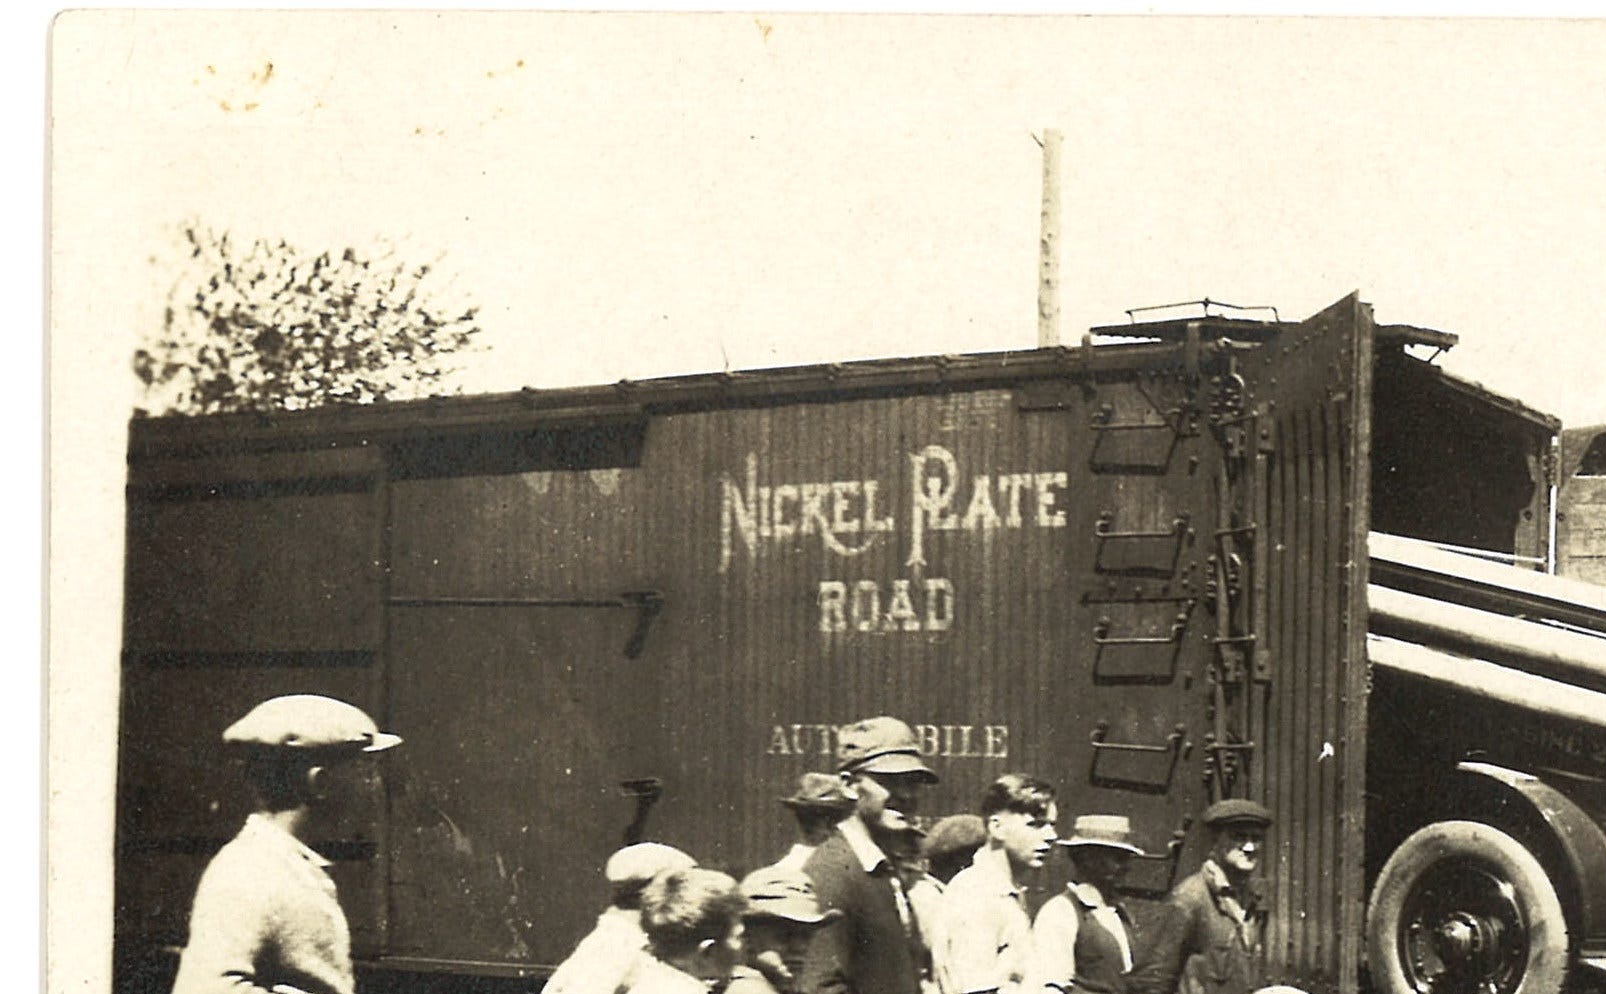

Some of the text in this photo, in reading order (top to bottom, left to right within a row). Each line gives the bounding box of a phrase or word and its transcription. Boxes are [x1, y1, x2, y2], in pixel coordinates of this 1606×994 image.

[716, 444, 1069, 575] NICKEL PLATE
[817, 577, 955, 633] ROAD
[766, 723, 1009, 759] AUTBILE
